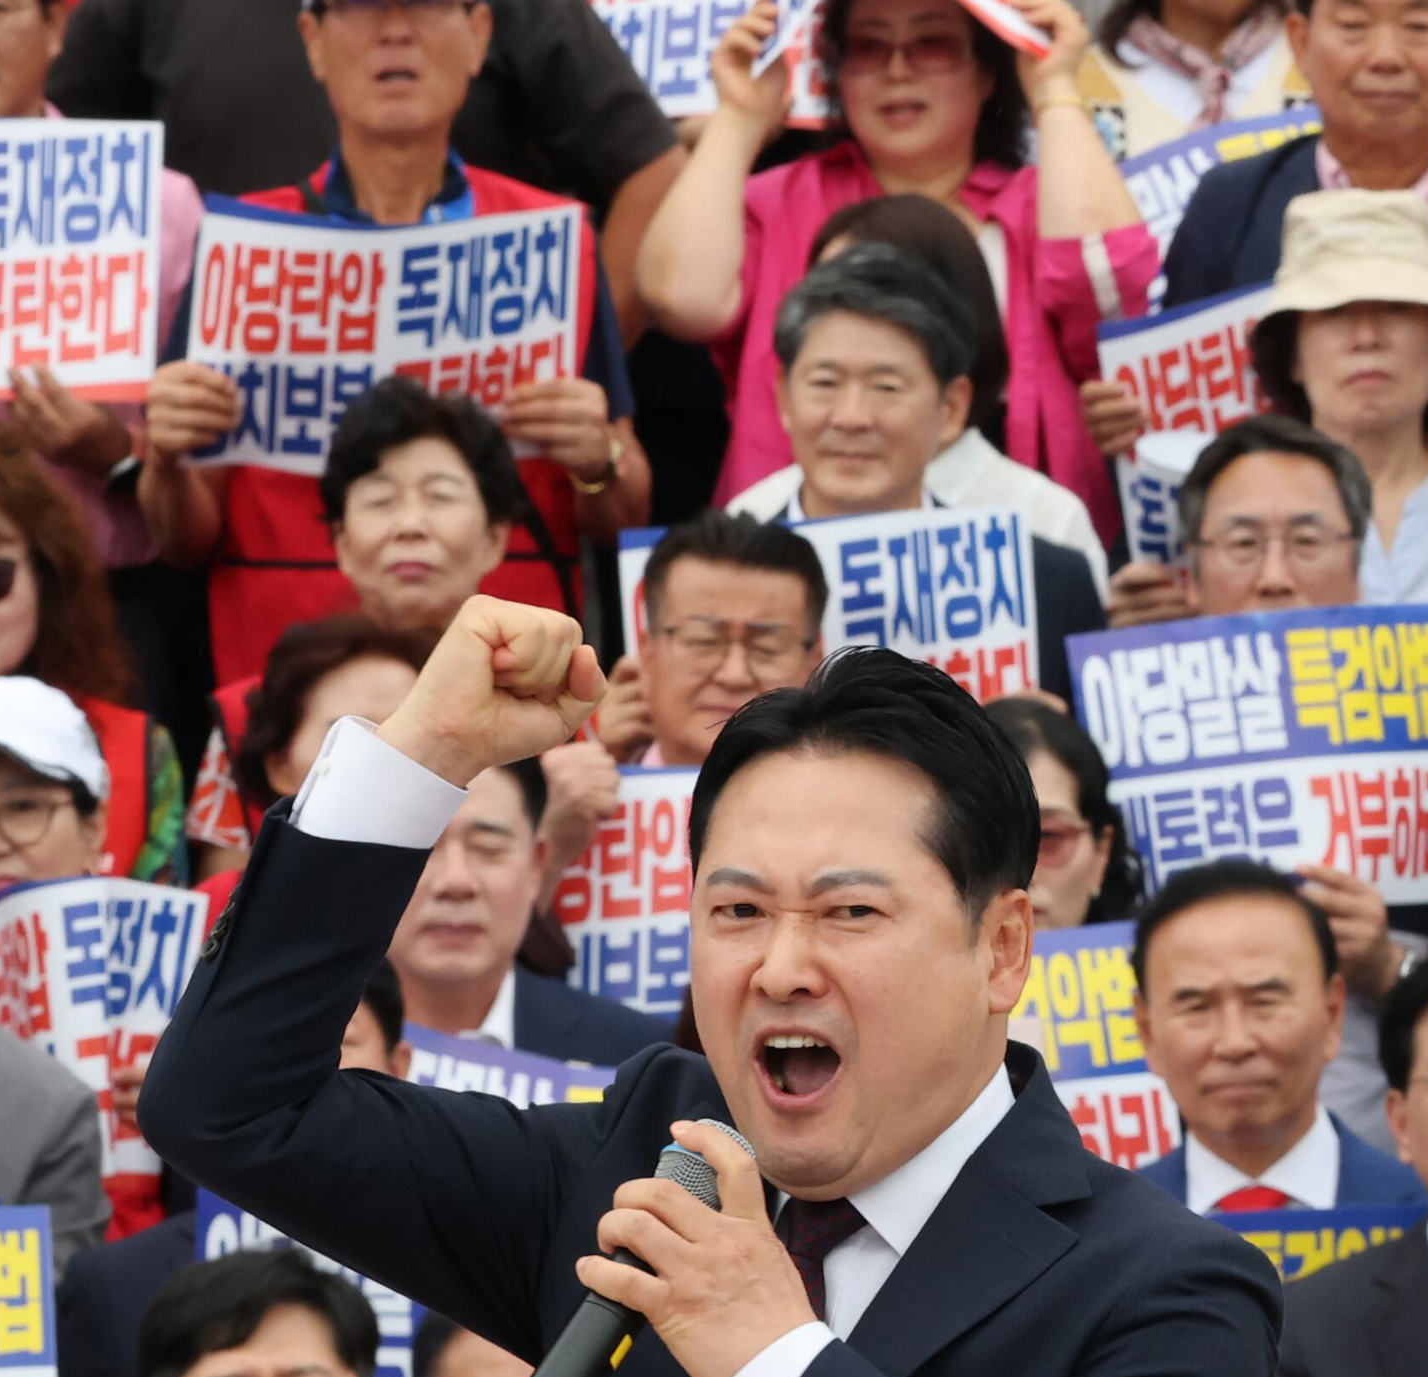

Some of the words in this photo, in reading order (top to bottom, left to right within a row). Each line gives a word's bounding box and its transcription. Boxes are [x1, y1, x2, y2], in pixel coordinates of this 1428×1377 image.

[199, 242, 384, 355] 야당탄압
[396, 216, 570, 346] 독재정치
[839, 512, 1026, 647] 독재정치
[1080, 630, 1285, 770] 야당말살
